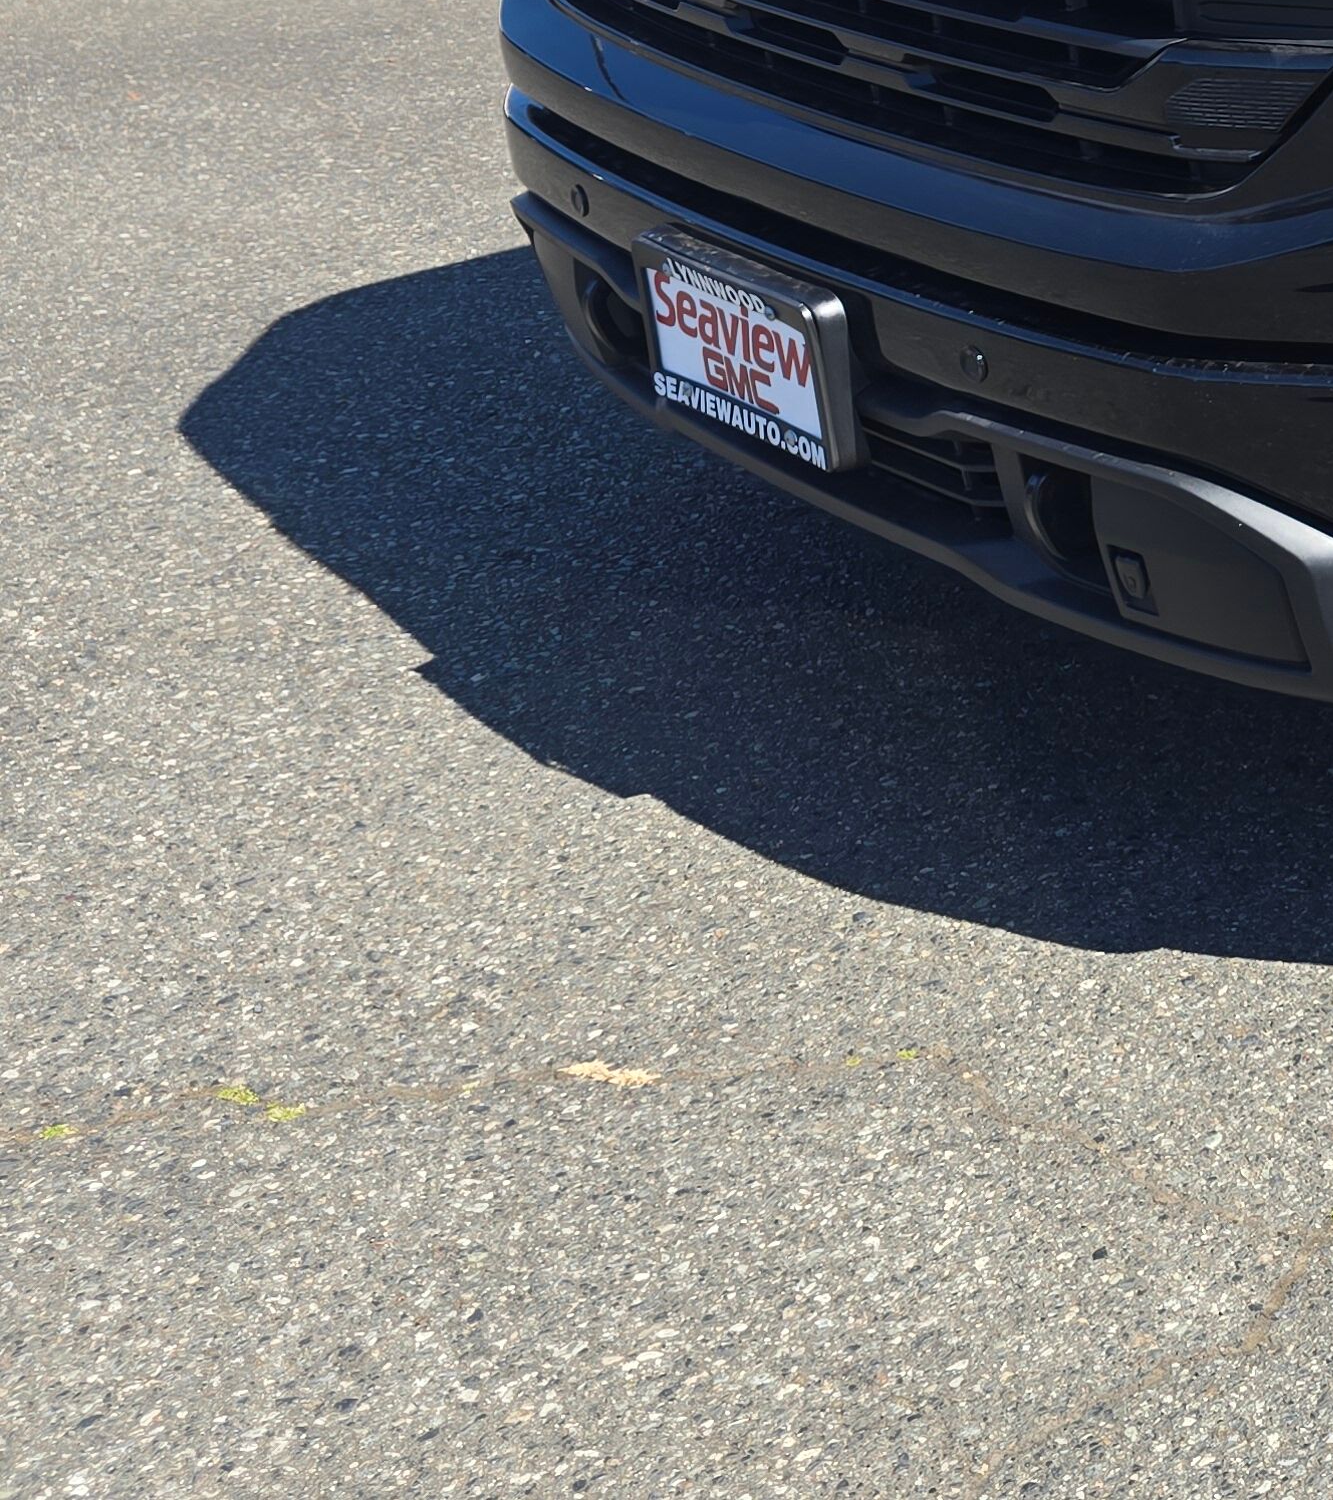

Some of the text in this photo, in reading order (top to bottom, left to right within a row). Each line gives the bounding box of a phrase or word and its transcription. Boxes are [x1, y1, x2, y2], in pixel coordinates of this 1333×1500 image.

[666, 257, 766, 314] LYNNWOOD
[654, 271, 812, 389] Seaview
[653, 371, 827, 471] SEAVIEWAUTO.COM
[702, 346, 780, 415] GMC
